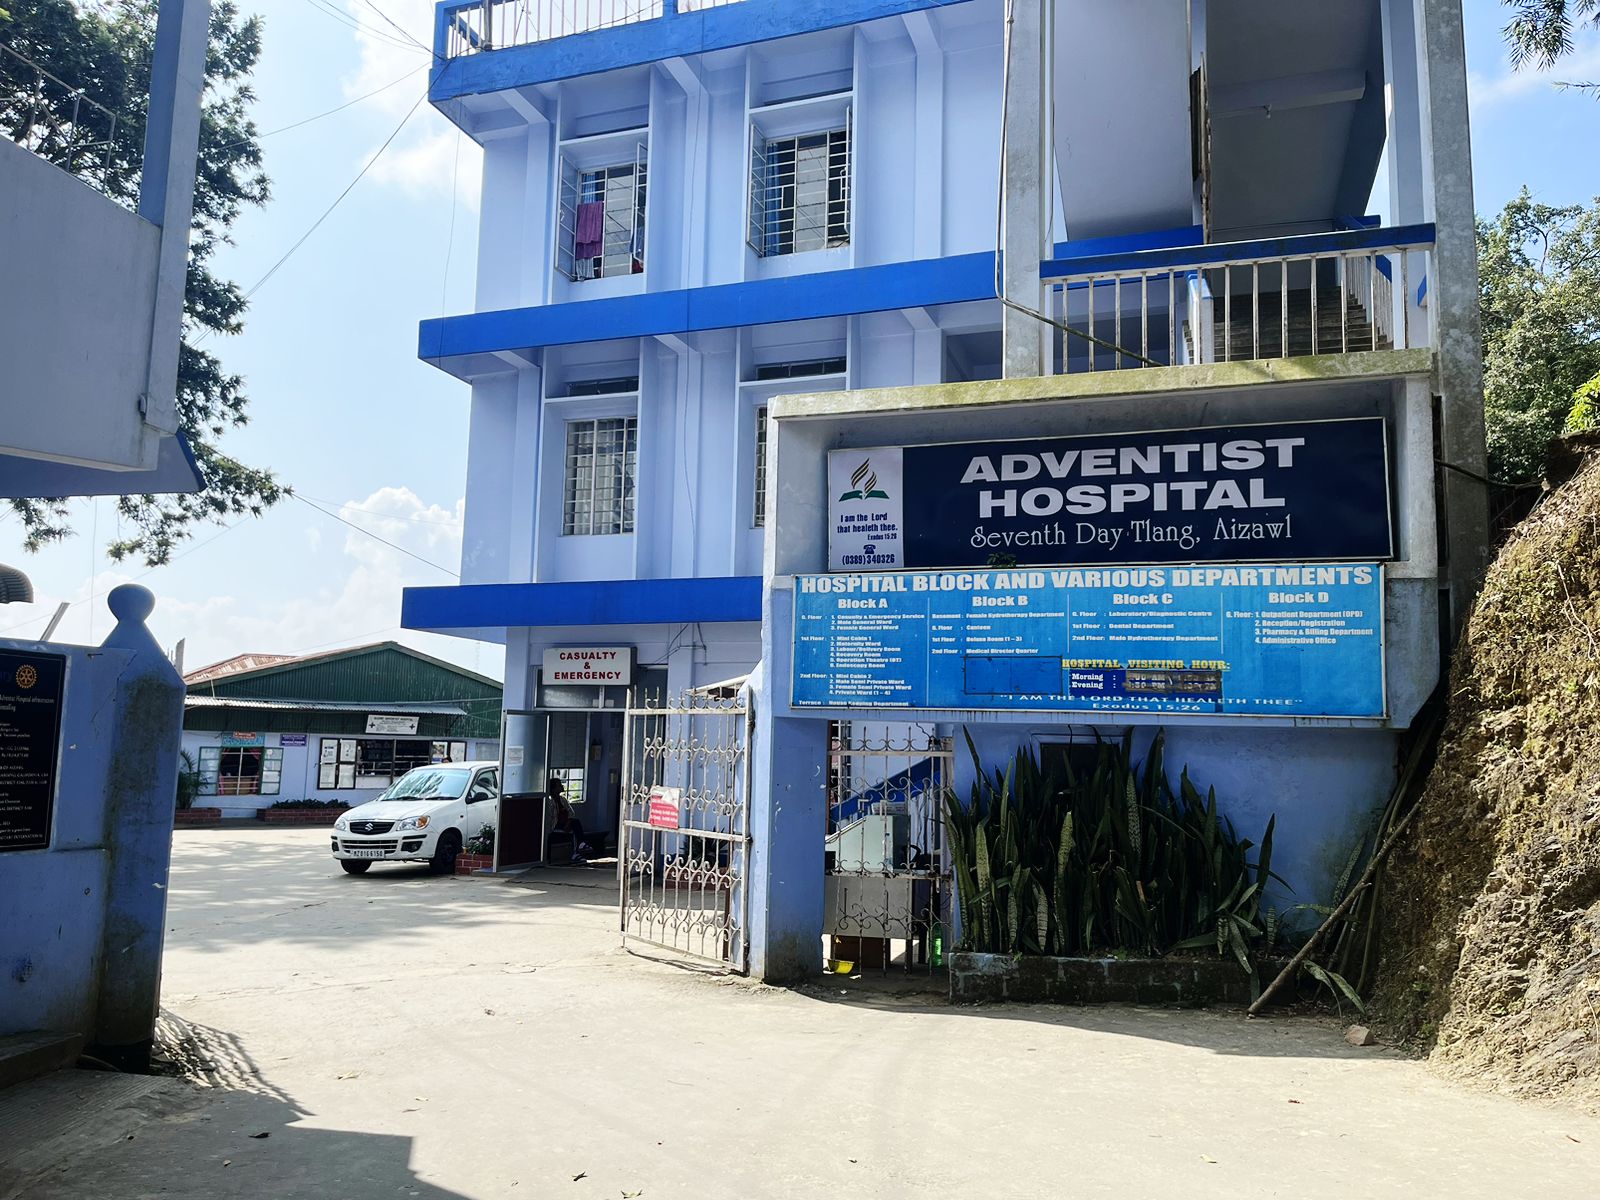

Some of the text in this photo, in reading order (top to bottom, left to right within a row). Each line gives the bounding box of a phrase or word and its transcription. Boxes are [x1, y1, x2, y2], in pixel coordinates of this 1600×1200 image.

[960, 438, 1305, 484] ADVENTIST
[979, 478, 1286, 518] HOSPITAL
[872, 513, 888, 521] Lord
[837, 523, 898, 533] that healeth thee.
[970, 514, 1293, 551] Seventh Day Tlang, Aizawl
[801, 566, 1373, 593] HOSPITAL BLOCK AND VARIOUS DEPARTMENTS
[972, 595, 1028, 607] Block B
[1113, 593, 1173, 605] Block C
[1269, 592, 1329, 603] Block D
[838, 598, 888, 609] Block A
[560, 652, 617, 660] CASUALTY
[584, 662, 591, 670] &
[1062, 659, 1231, 669] HOSPITAL VISITING HOUR:
[554, 672, 621, 680] EMERGENCY
[1071, 673, 1104, 682] Morning
